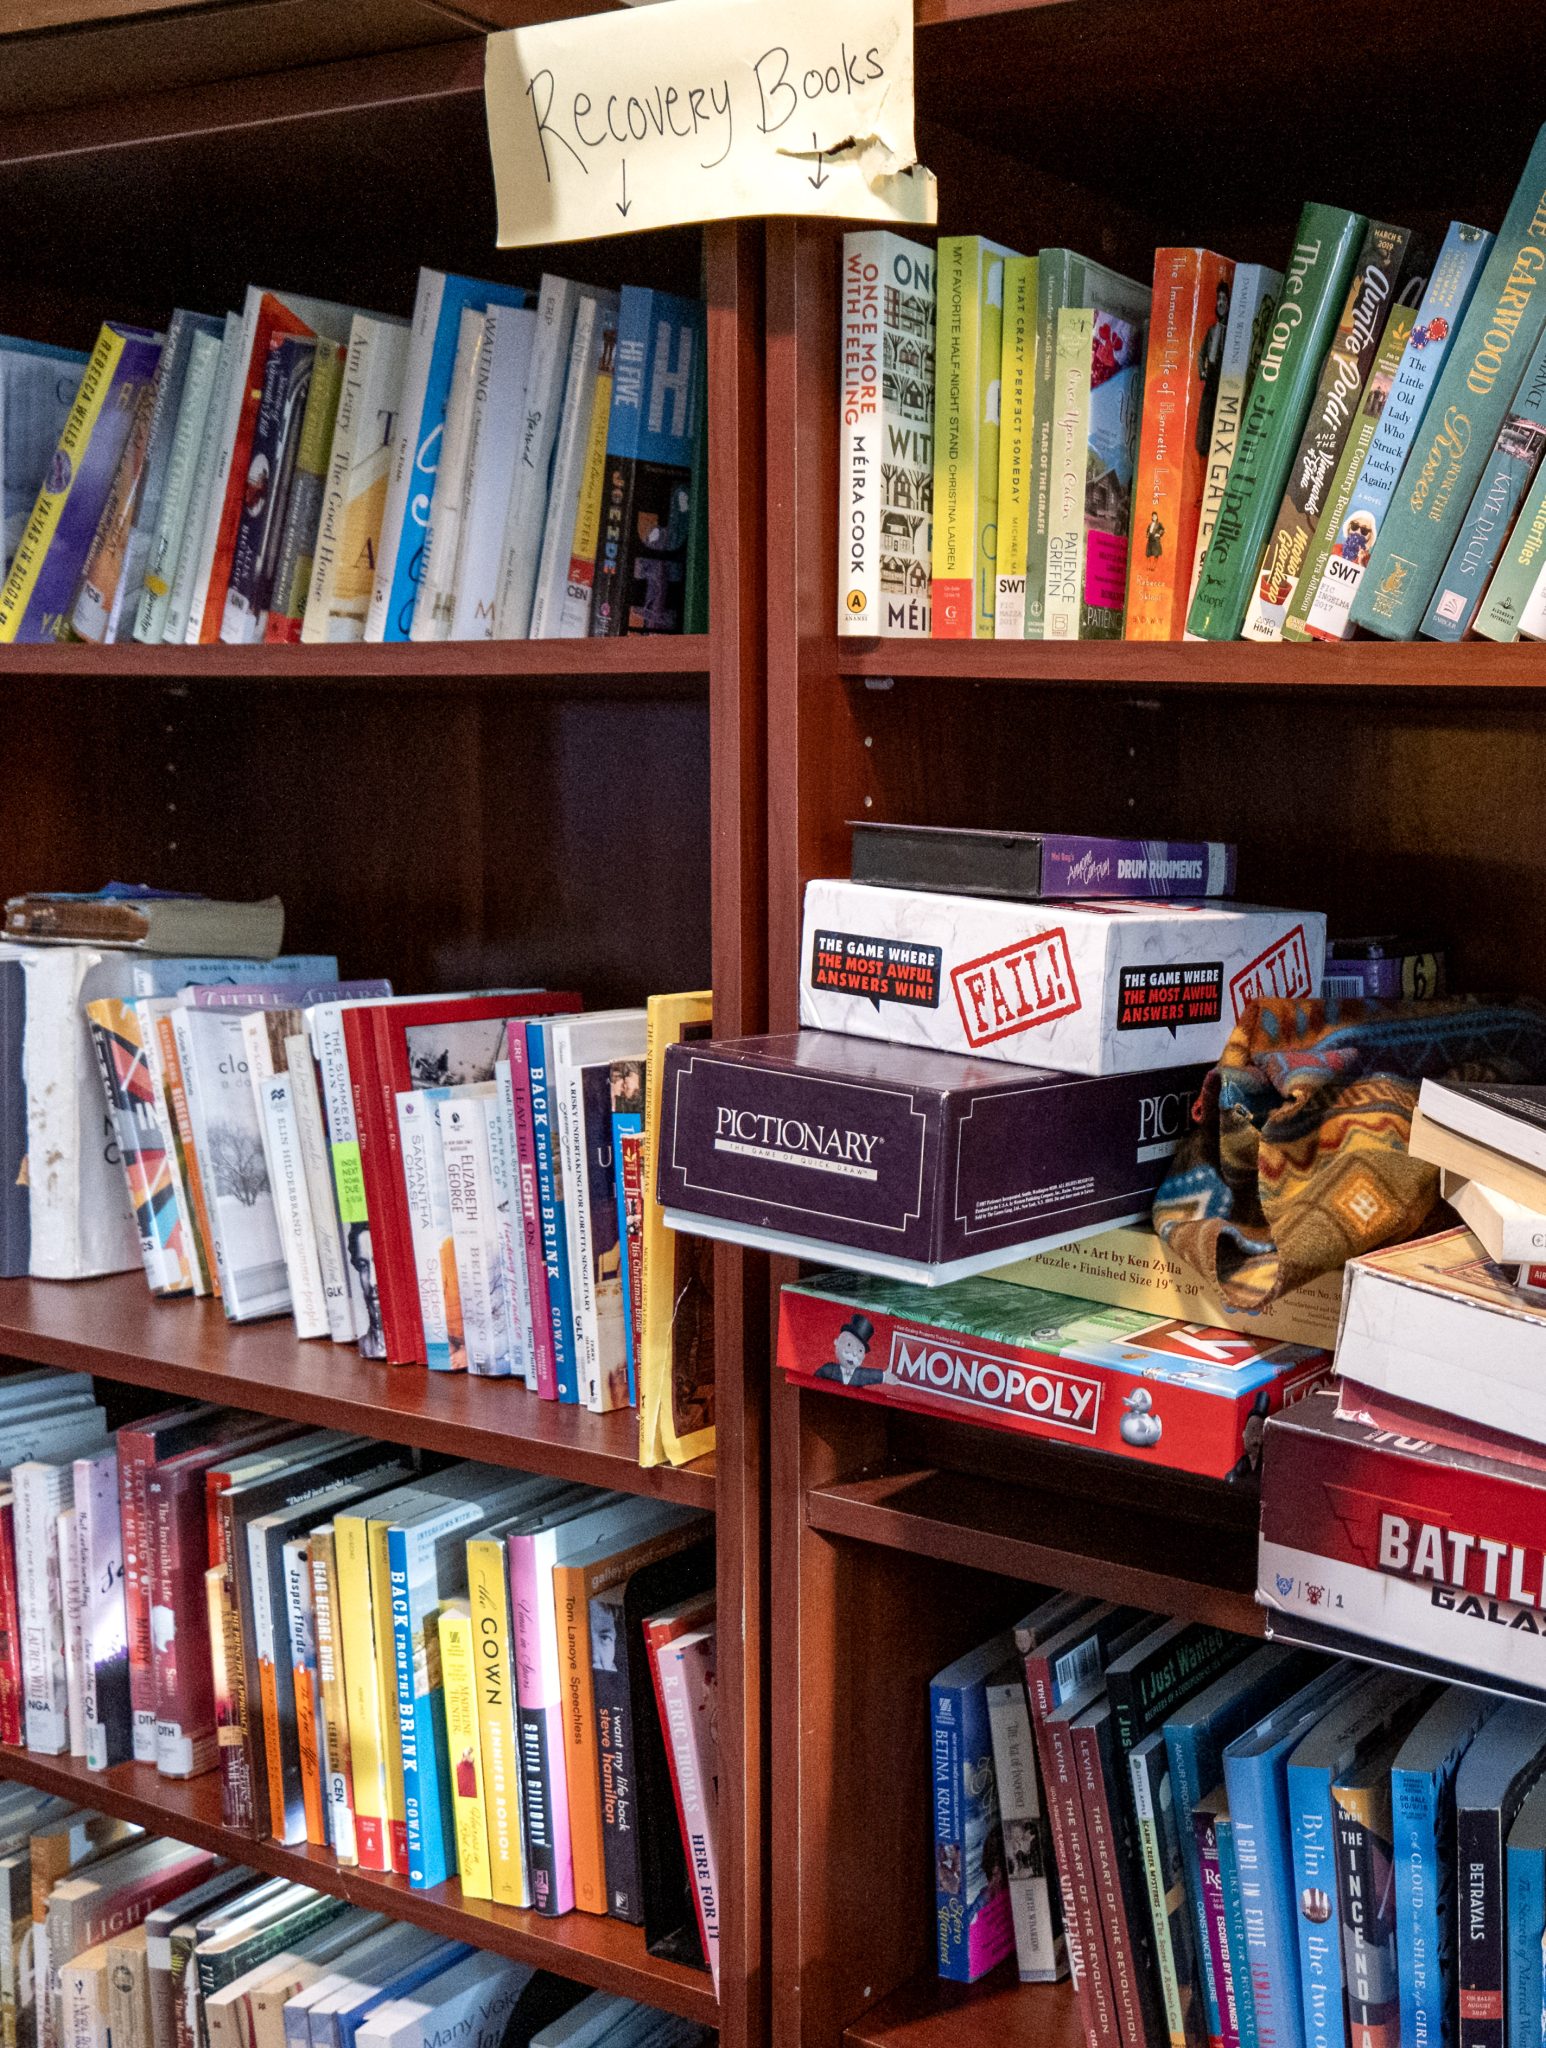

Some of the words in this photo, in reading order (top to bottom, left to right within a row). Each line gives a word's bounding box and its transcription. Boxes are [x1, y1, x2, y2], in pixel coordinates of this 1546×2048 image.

[526, 68, 735, 183] Recovery
[754, 42, 885, 134] Books
[846, 253, 861, 314] WITH
[1286, 238, 1321, 296] The
[862, 264, 879, 335] ONCE
[950, 272, 962, 338] FAVORITE
[1016, 276, 1026, 312] THAT
[1165, 285, 1184, 343] Immortal
[1345, 264, 1390, 355] Auntie
[1014, 317, 1024, 363] CRAZY
[1261, 301, 1303, 383] Coup
[1465, 245, 1546, 396] GARWOOD
[82, 338, 112, 403] REBECCA
[477, 315, 498, 402] WAITING
[844, 323, 861, 426] FEELING
[860, 344, 878, 414] MORE
[949, 339, 961, 415] HALF-NIGHT
[1159, 349, 1178, 376] Life
[1399, 373, 1425, 391] Little
[1409, 356, 1427, 373] The
[614, 363, 643, 410] FIVE
[1322, 352, 1361, 434] Poldi
[1397, 390, 1416, 407] Old
[62, 402, 88, 449] WELLS
[948, 418, 960, 460] STAND
[1040, 420, 1050, 453] TEARS
[1383, 423, 1406, 441] Who
[1388, 407, 1411, 425] Lady
[852, 436, 869, 504] MÉIRA
[1011, 439, 1022, 505] SOMEDAY
[1339, 449, 1366, 496] Country
[1366, 456, 1398, 477] Lucky
[1372, 439, 1404, 459] Struck
[946, 463, 958, 524] CHRISTINA
[1202, 463, 1229, 537] GATE
[1360, 473, 1394, 492] Again!
[1483, 471, 1513, 516] KAYE
[321, 492, 344, 546] Good
[1036, 491, 1047, 535] GIRAFFE
[1210, 472, 1257, 565] Updike
[1324, 495, 1353, 543] Reunion
[850, 511, 866, 573] COOK
[945, 527, 957, 571] LAUREN
[1459, 517, 1495, 578] DACUS
[2, 566, 29, 608] BLOOM
[314, 547, 335, 604] House
[1000, 579, 1025, 594] SWT
[1048, 537, 1064, 598] GRIFFIN
[1061, 531, 1079, 604] PATIENCE
[1329, 559, 1361, 585] SWT
[1118, 859, 1147, 879] DRUM
[1150, 860, 1204, 880] RUDIMENTS
[820, 937, 843, 953] THE
[846, 941, 885, 960] GAME
[889, 947, 936, 967] WHERE
[845, 956, 884, 976] MOST
[887, 962, 935, 984] AWFUL
[816, 969, 890, 994] ANSWERS
[895, 980, 934, 1001] WIN!
[963, 943, 1065, 1034] FAIL!
[1149, 971, 1182, 986] GAME
[1184, 968, 1220, 984] WHERE
[1149, 987, 1180, 1002] MOST
[1182, 985, 1218, 1001] AWFUL
[1121, 1004, 1185, 1024] ANSWERS
[323, 1032, 336, 1090] ALISON
[645, 1049, 654, 1086] NIGHT
[335, 1062, 350, 1127] SUMMER
[515, 1086, 527, 1132] LEAVE
[531, 1066, 548, 1127] BACK
[569, 1088, 578, 1118] RISKY
[644, 1089, 653, 1130] BEFORE
[277, 1117, 290, 1146] ELIN
[537, 1132, 548, 1171] FROM
[572, 1120, 585, 1189] UNDERTAKING
[716, 1106, 879, 1164] PICTIONARY
[730, 1143, 746, 1152] THE
[752, 1146, 778, 1159] GAME
[404, 1157, 420, 1212] CHASE
[411, 1133, 431, 1230] SAMANTHA
[643, 1132, 653, 1194] CHRISTMAS
[281, 1149, 302, 1237] HILDERBRAND
[447, 1163, 465, 1214] GEORGE
[460, 1154, 479, 1222] ELIZABETH
[521, 1162, 536, 1220] LIGHT
[540, 1175, 550, 1201] THE
[525, 1221, 536, 1246] ON
[542, 1206, 561, 1280] BRINK
[578, 1206, 588, 1249] LORETTA
[581, 1251, 592, 1312] SINGLETARY
[632, 1259, 644, 1305] Christmas
[1035, 1253, 1071, 1270] Puzzle
[1079, 1261, 1127, 1282] Finished
[1129, 1271, 1153, 1288] Size
[1090, 1246, 1109, 1261] Art
[1111, 1249, 1125, 1267] by
[1127, 1254, 1150, 1270] Ken
[1152, 1258, 1182, 1276] Zylla
[326, 1287, 344, 1299] GLK
[426, 1257, 444, 1342] Suddenly
[470, 1246, 488, 1343] BELIEVING
[551, 1306, 565, 1363] COWAN
[635, 1307, 645, 1334] Bride
[897, 1341, 1094, 1422] MONOPOLY
[123, 1464, 135, 1513] WANT
[158, 1525, 172, 1577] Invisible
[1380, 1513, 1546, 1612] BATTL
[162, 1579, 174, 1603] Life
[291, 1569, 303, 1605] Jasper
[312, 1560, 328, 1592] DEAD
[390, 1570, 409, 1629] BACK
[295, 1608, 306, 1655] Fforde
[565, 1595, 577, 1628] Tom
[395, 1632, 409, 1671] FROM
[481, 1616, 504, 1706] GOWN
[566, 1631, 578, 1671] Lanoye
[398, 1674, 410, 1699] THE
[1149, 1663, 1178, 1699] Just
[570, 1676, 585, 1747] Speechless
[600, 1708, 612, 1749] steve
[612, 1715, 624, 1748] want
[669, 1698, 687, 1737] ERIC
[399, 1702, 418, 1773] BRINK
[490, 1720, 506, 1790] JENNIFER
[523, 1722, 543, 1772] SHEILA
[935, 1729, 951, 1781] BETINA
[1053, 1732, 1068, 1784] LEVINE
[332, 1776, 346, 1803] CEN
[602, 1753, 616, 1825] hamilton
[615, 1773, 628, 1800] life
[677, 1742, 700, 1813] THOMAS
[1080, 1740, 1095, 1792] LEVINE
[406, 1797, 422, 1852] COWAN
[495, 1792, 511, 1862] ROBSON
[617, 1802, 631, 1832] back
[937, 1785, 953, 1840] KRAHN
[1065, 1798, 1077, 1827] THE
[1093, 1805, 1106, 1834] THE
[692, 1834, 711, 1880] HERE
[1071, 1831, 1086, 1880] HEART
[1097, 1838, 1114, 1888] HEART
[1237, 1839, 1258, 1871] GIRL
[1341, 1831, 1363, 1846] THE
[700, 1885, 716, 1919] FOR
[1410, 1852, 1425, 1909] CLOUD
[1469, 1862, 1485, 1941] BETRAYALS
[86, 1898, 156, 1947] LIGHT
[1084, 1907, 1096, 1936] THE
[1111, 1916, 1124, 1946] THE
[1244, 1907, 1267, 1948] EXILE
[1195, 1901, 1213, 1961] CONSTANCE
[1204, 1963, 1218, 2003] LEISURE
[1216, 1915, 1231, 1962] ESCORTED
[1227, 1995, 1239, 2031] RANGER
[1307, 1936, 1330, 1975] the
[1412, 1938, 1427, 1990] SHAPE
[1088, 1940, 1110, 2035] REVOLUTION
[1116, 1950, 1139, 2044] REVOLUTION
[1311, 1983, 1329, 2027] two
